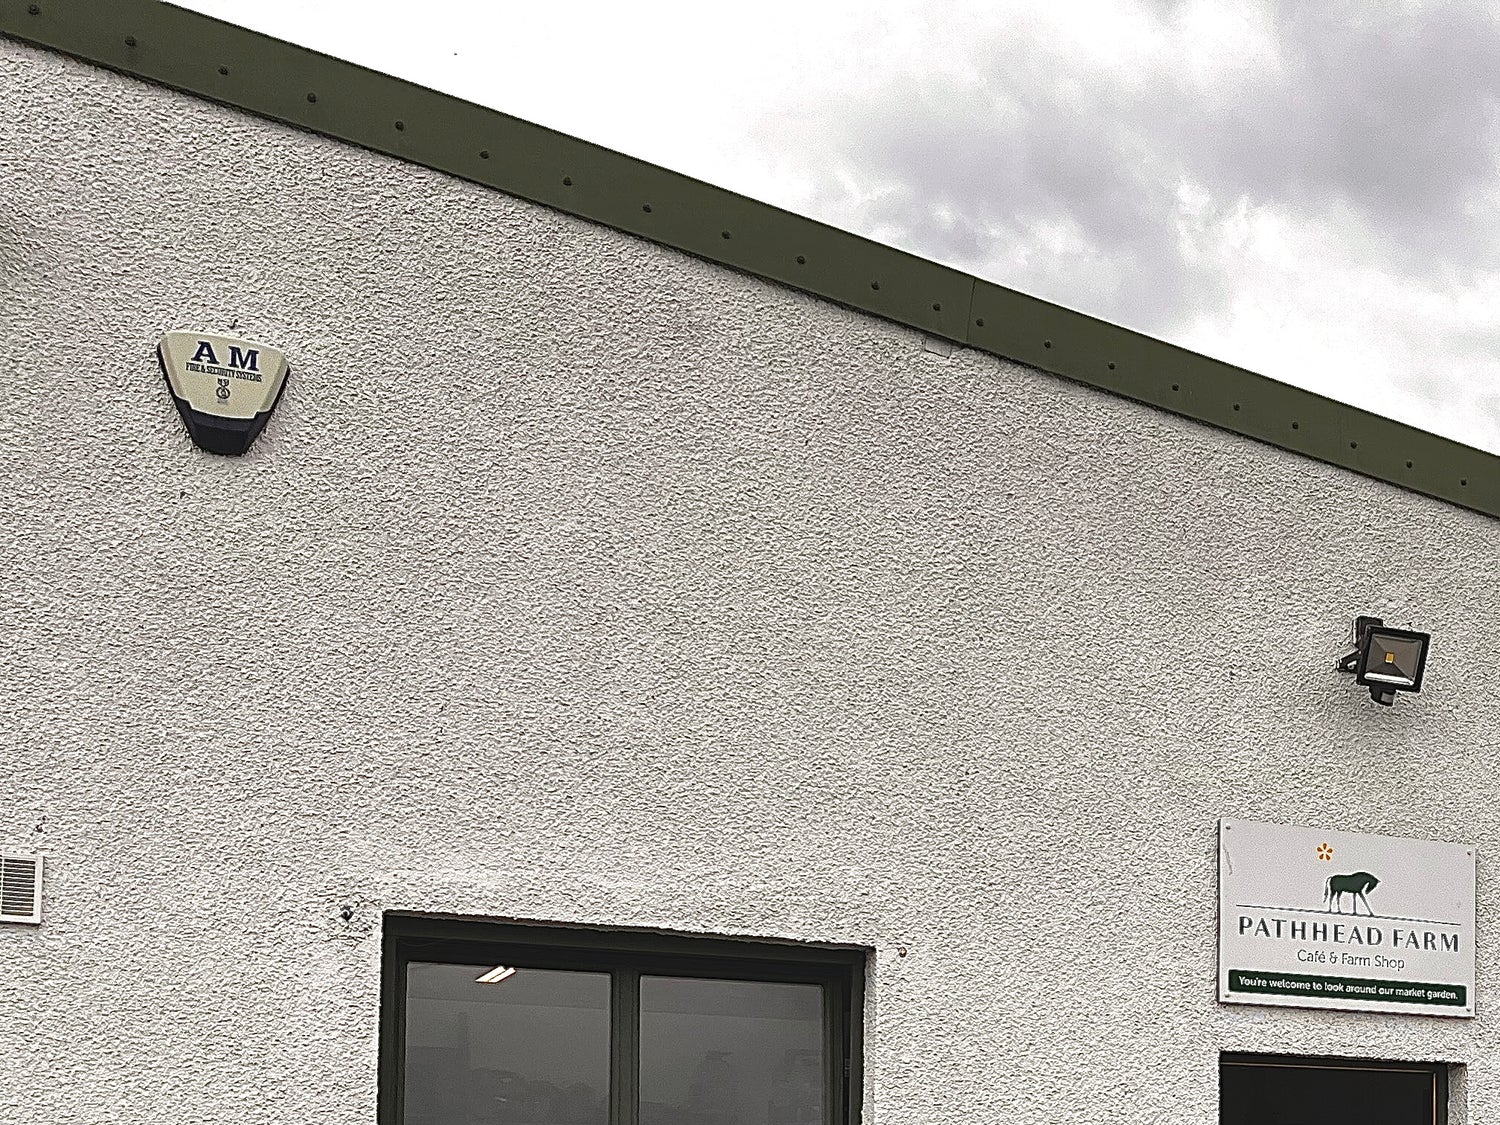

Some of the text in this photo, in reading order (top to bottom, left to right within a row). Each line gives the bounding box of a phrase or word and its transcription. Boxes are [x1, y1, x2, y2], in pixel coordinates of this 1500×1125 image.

[206, 366, 235, 378] SECURITY
[236, 371, 262, 382] SYSTEMS
[1238, 915, 1460, 953] PATHHEAD FARM
[1297, 949, 1405, 972] Café & Farm Shop
[1238, 975, 1459, 1001] You're welcome to look around our market garden.
